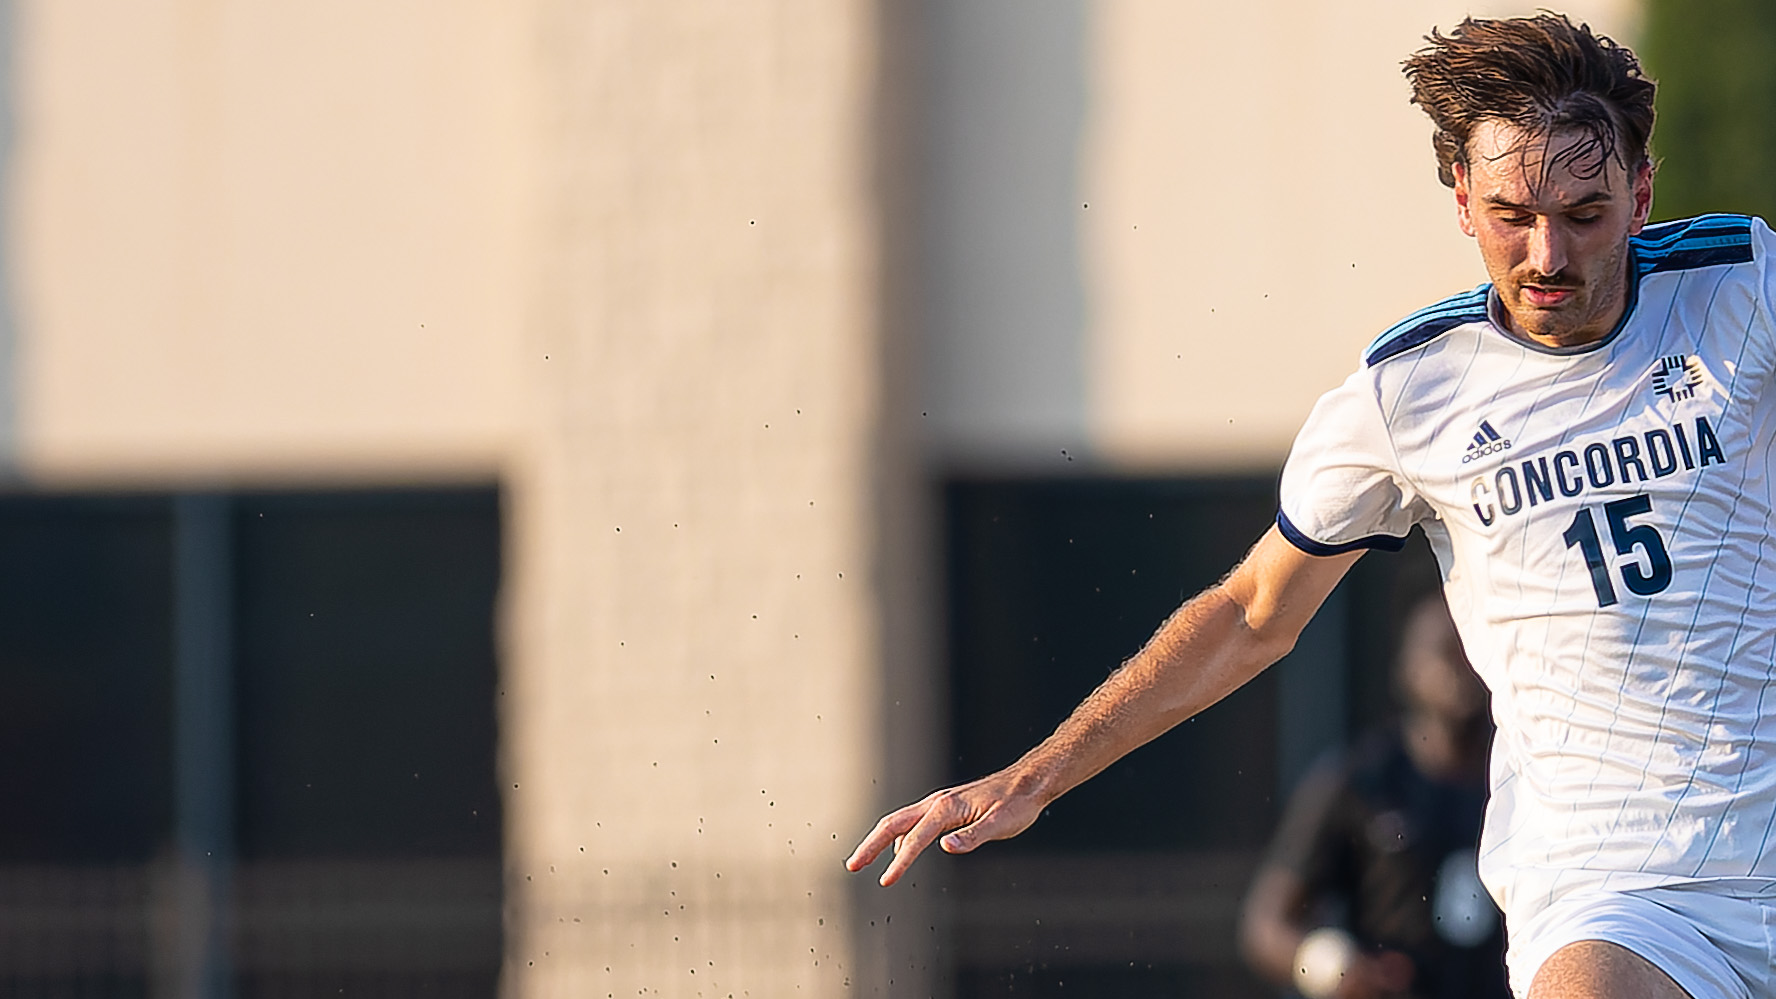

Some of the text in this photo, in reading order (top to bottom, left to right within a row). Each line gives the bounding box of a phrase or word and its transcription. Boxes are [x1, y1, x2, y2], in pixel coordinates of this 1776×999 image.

[1462, 439, 1512, 464] adidas
[1470, 416, 1726, 527] CONCORDIA
[1563, 494, 1672, 608] 15
